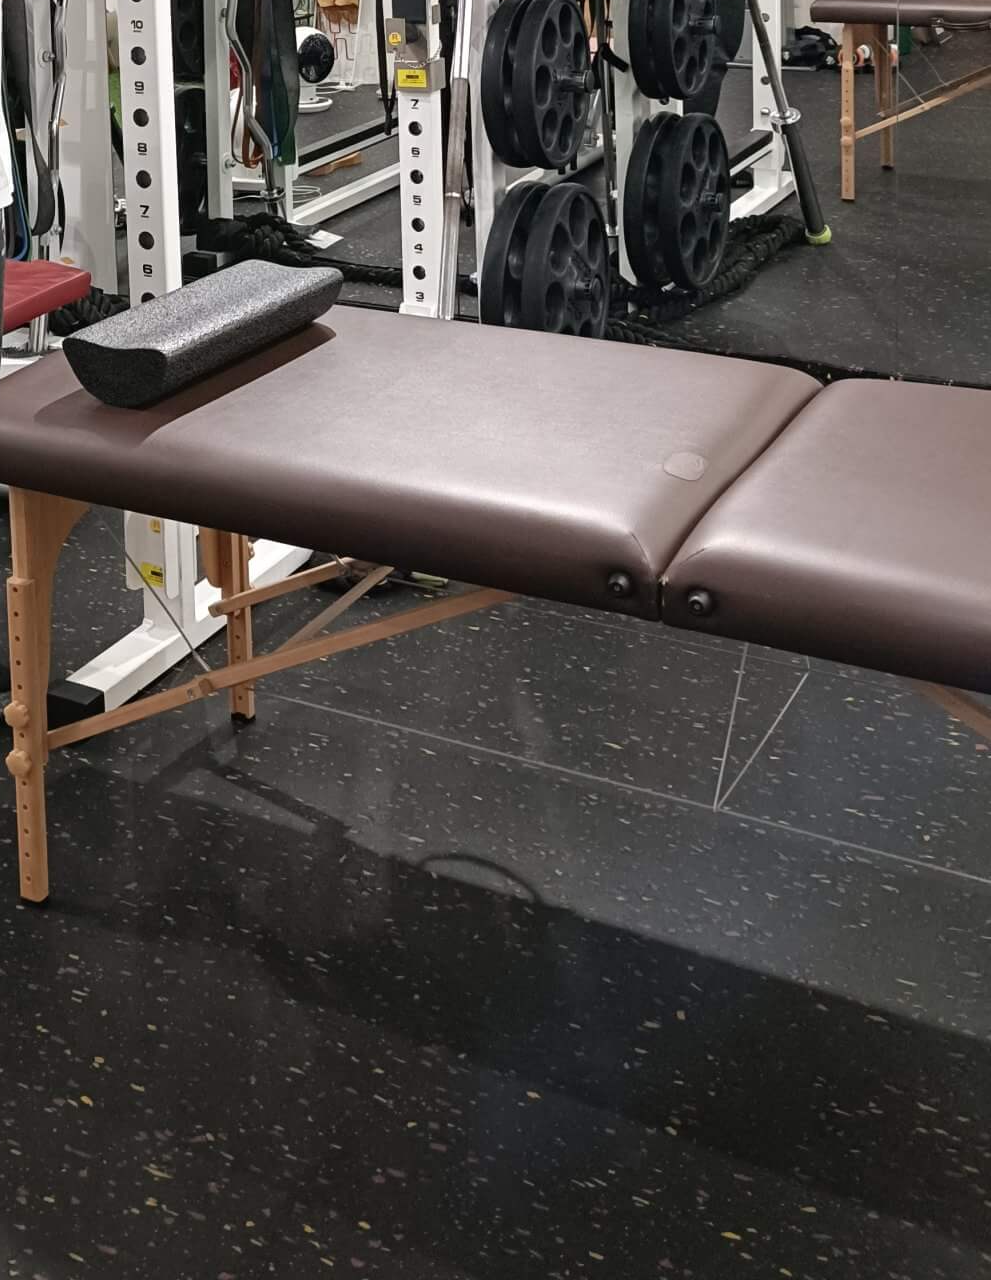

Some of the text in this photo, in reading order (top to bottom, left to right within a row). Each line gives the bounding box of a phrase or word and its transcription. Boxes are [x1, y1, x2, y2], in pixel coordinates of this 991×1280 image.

[131, 20, 143, 32] 10
[135, 81, 144, 94] 9
[411, 99, 419, 108] 7
[138, 143, 147, 155] 8
[412, 147, 420, 157] 6
[413, 195, 421, 205] 5
[140, 205, 149, 217] 7
[415, 244, 423, 253] 4
[143, 264, 152, 277] 6
[416, 292, 424, 302] 3
